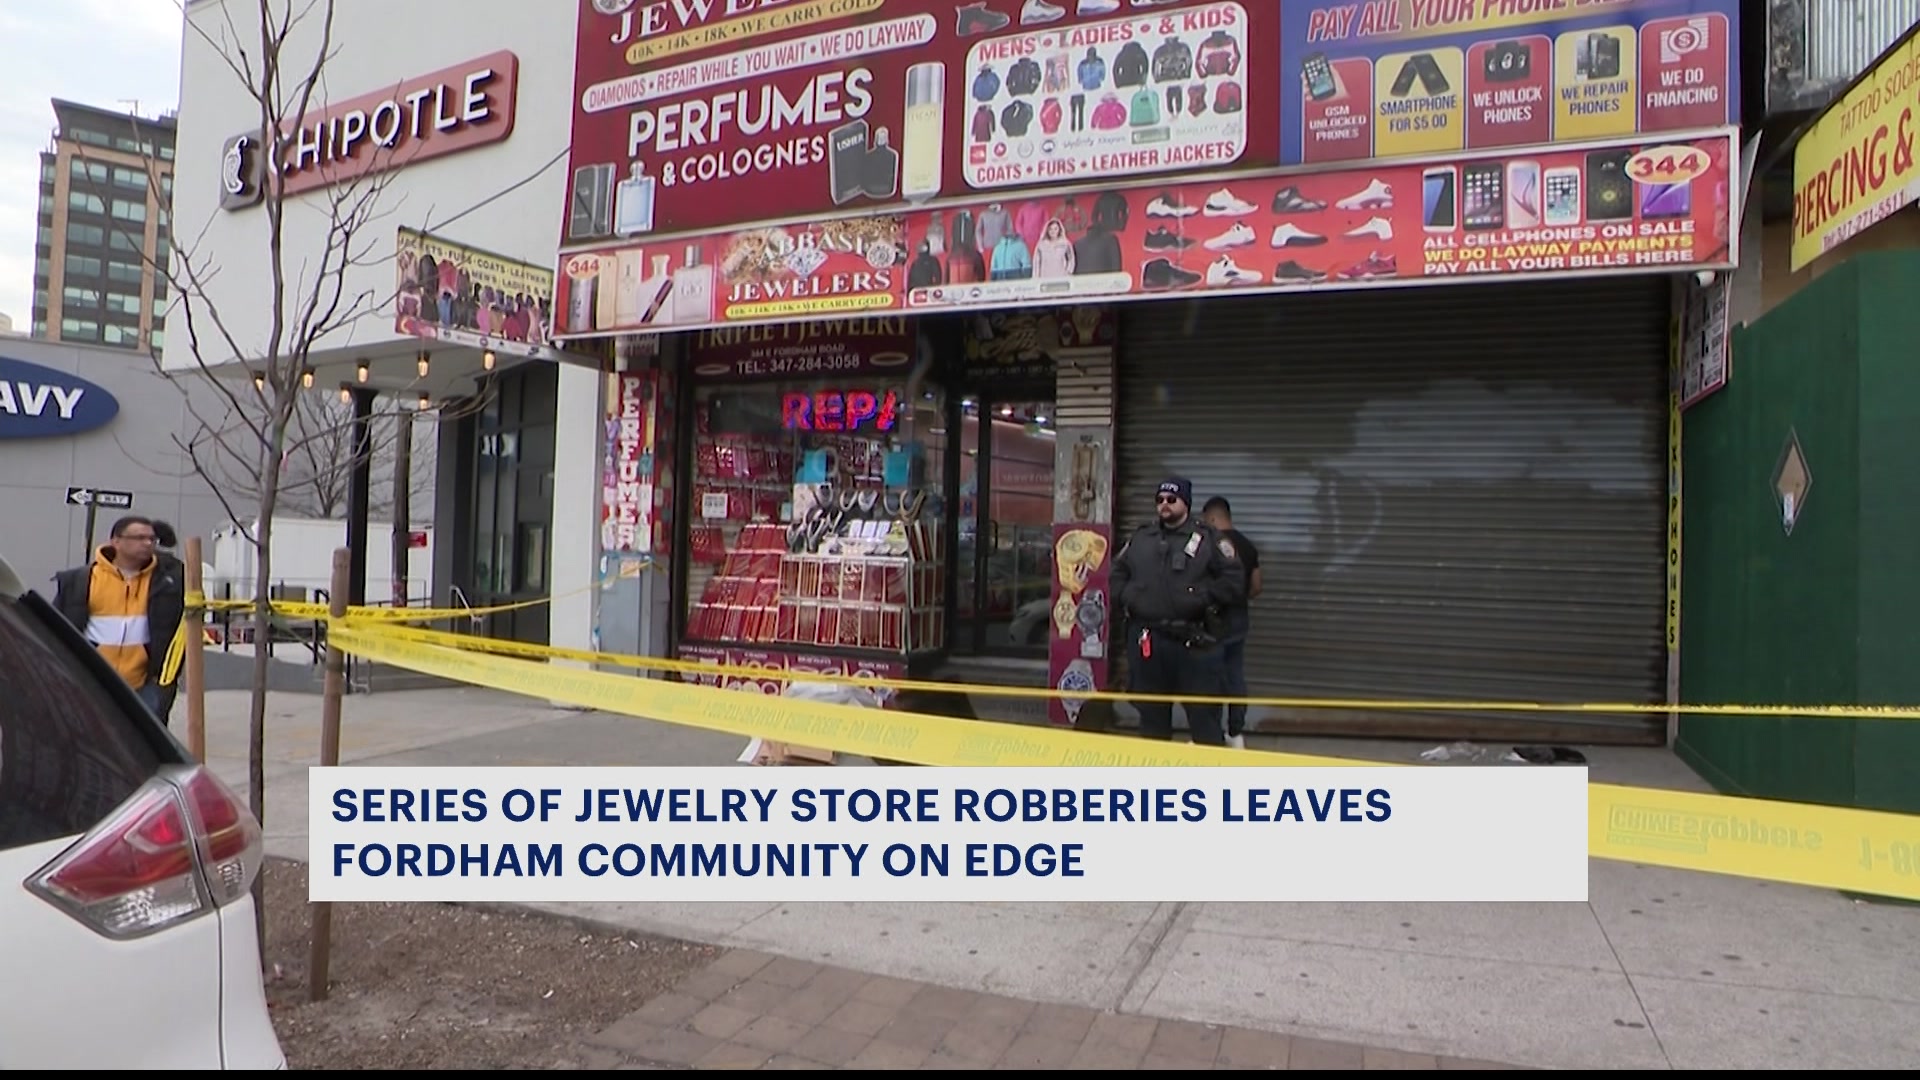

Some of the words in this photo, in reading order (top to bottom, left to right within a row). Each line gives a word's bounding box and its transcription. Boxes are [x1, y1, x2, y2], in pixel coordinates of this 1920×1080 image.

[668, 36, 691, 50] 14K
[703, 25, 729, 42] 18K
[741, 18, 766, 34] WE
[770, 6, 827, 28] CARRY
[830, 0, 878, 13] GOLD
[978, 37, 1036, 62] MENS
[1058, 23, 1133, 49] LADIES
[1157, 16, 1177, 35] &
[1183, 5, 1237, 32] KIDS
[1307, 3, 1358, 43] PAY
[1357, 0, 1402, 37] ALL
[1409, 0, 1474, 30] YOUR
[588, 77, 646, 109] DIAMONDS
[656, 66, 698, 93] REPAIR
[700, 57, 739, 83] WHILE
[745, 51, 771, 73] YOU
[774, 41, 807, 67] WAIT
[820, 33, 841, 57] WE
[845, 29, 864, 51] DO
[867, 19, 926, 49] LAYWAY
[1660, 70, 1682, 86] WE
[1684, 67, 1704, 84] DO
[1472, 91, 1493, 108] WE
[1494, 87, 1543, 106] UNLOCK
[1561, 86, 1580, 100] WE
[1583, 80, 1629, 98] REPAIR
[1646, 86, 1718, 109] FINANCING
[627, 67, 874, 158] PERFUMES
[1324, 105, 1350, 117] GSM
[1379, 94, 1457, 117] SMARTPHONE
[1483, 105, 1532, 125] PHONES
[1569, 98, 1620, 116] PHONES
[1840, 87, 1881, 139] TATTOO
[268, 67, 495, 175] CHIPOTLE
[1309, 115, 1367, 131] UNLOCKED
[1389, 118, 1411, 133] FOR
[1315, 128, 1360, 142] PHONES
[662, 164, 677, 187] &
[681, 135, 826, 185] COLOGNES
[976, 163, 1022, 184] COATS
[1037, 157, 1076, 177] FURS
[1091, 148, 1159, 172] LEATHER
[1163, 141, 1236, 165] JACKETS
[1633, 153, 1700, 178] 344
[1792, 124, 1888, 246] PIERCING
[1893, 107, 1914, 176] &
[1423, 235, 1458, 248] ALL
[1464, 227, 1596, 247] CELLPHONES
[1602, 224, 1633, 238] ON
[1638, 220, 1695, 236] SALE
[400, 237, 443, 257] JACETS
[477, 258, 506, 274] COATS
[759, 231, 865, 266] ABBASI
[1424, 248, 1453, 262] WE
[1459, 247, 1487, 261] DO
[1492, 243, 1573, 259] LAYWAY
[1579, 234, 1694, 255] PAYMENTS
[570, 259, 599, 275] 344
[1424, 260, 1458, 275] PAY
[1466, 258, 1502, 273] ALL
[1507, 255, 1565, 270] YOUR
[1570, 252, 1630, 268] BILLS
[1635, 249, 1694, 264] HERE
[728, 270, 892, 302] JEWELERS
[820, 299, 856, 310] CARRY
[858, 296, 889, 307] GOLD
[736, 360, 767, 375] TEL:
[769, 353, 860, 372] 347-284-3058
[614, 376, 641, 551] PERFUMES
